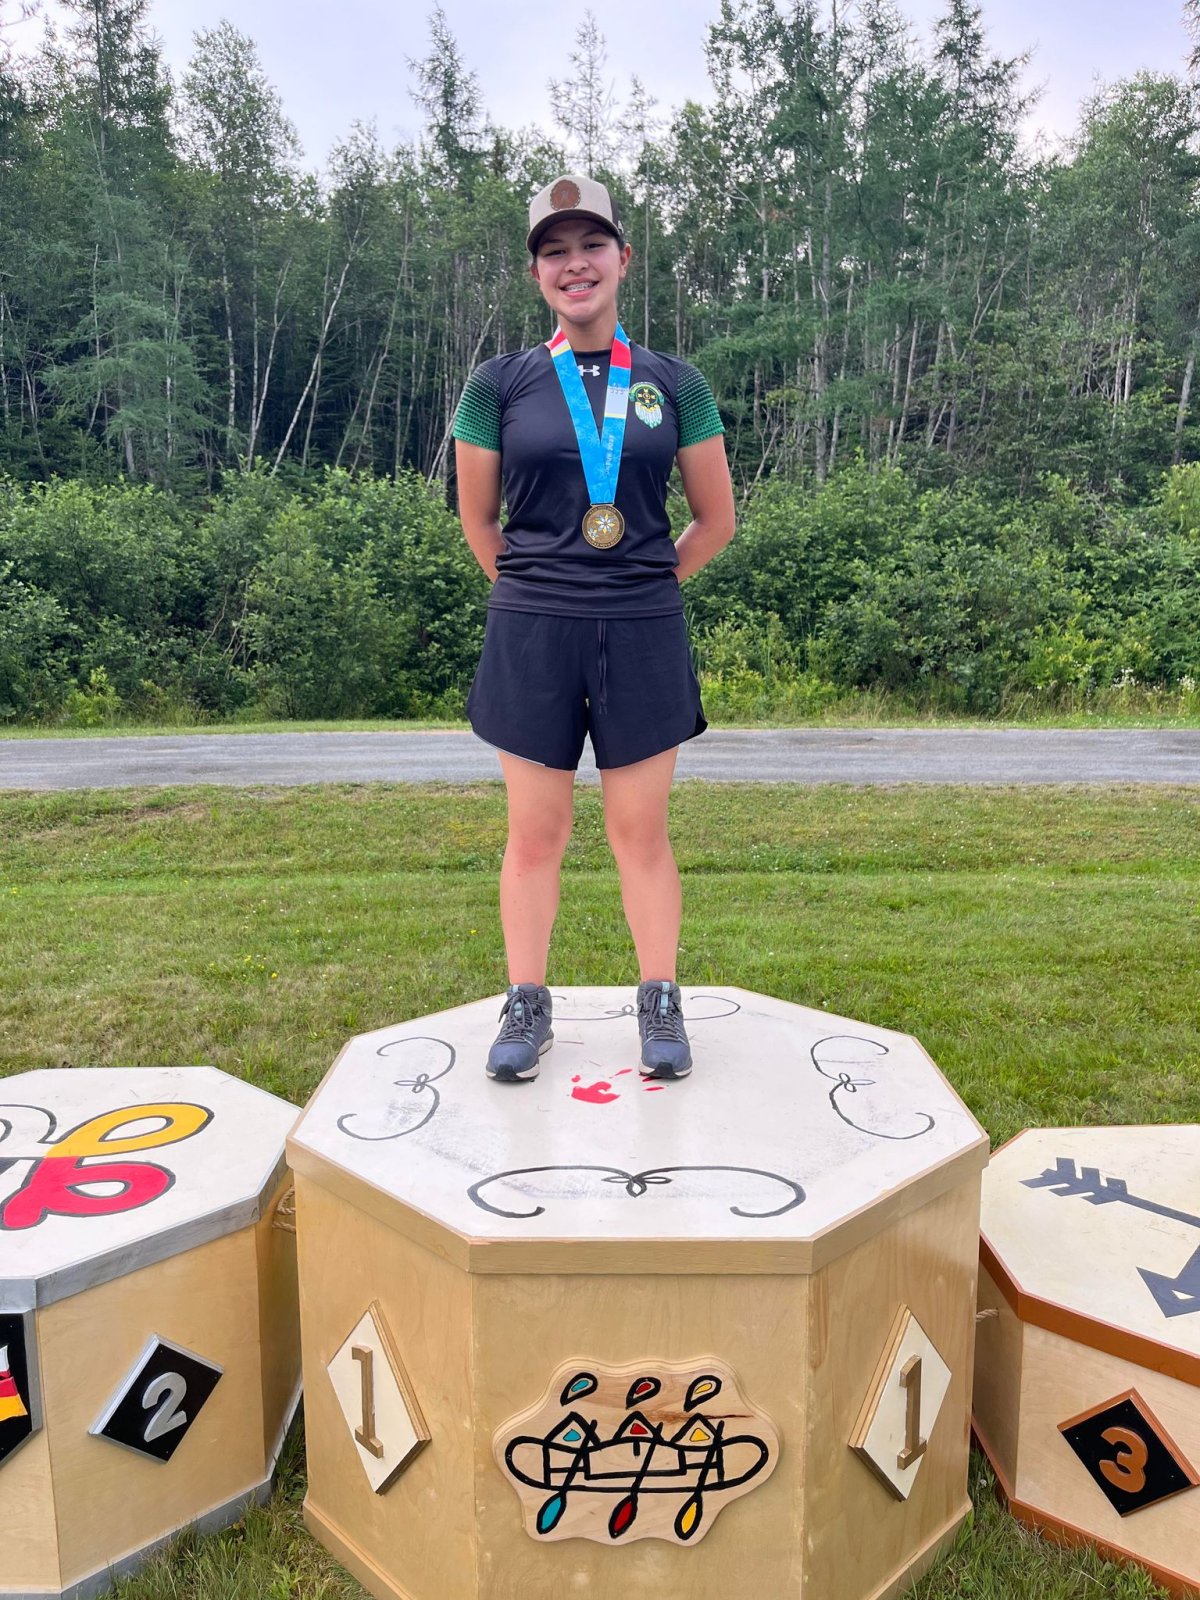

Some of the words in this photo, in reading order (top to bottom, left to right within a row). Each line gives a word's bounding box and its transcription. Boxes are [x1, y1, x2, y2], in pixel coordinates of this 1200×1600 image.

[142, 1371, 187, 1443] 2
[352, 1345, 384, 1459] 1
[897, 1353, 927, 1470] 1
[1099, 1426, 1149, 1493] 3
